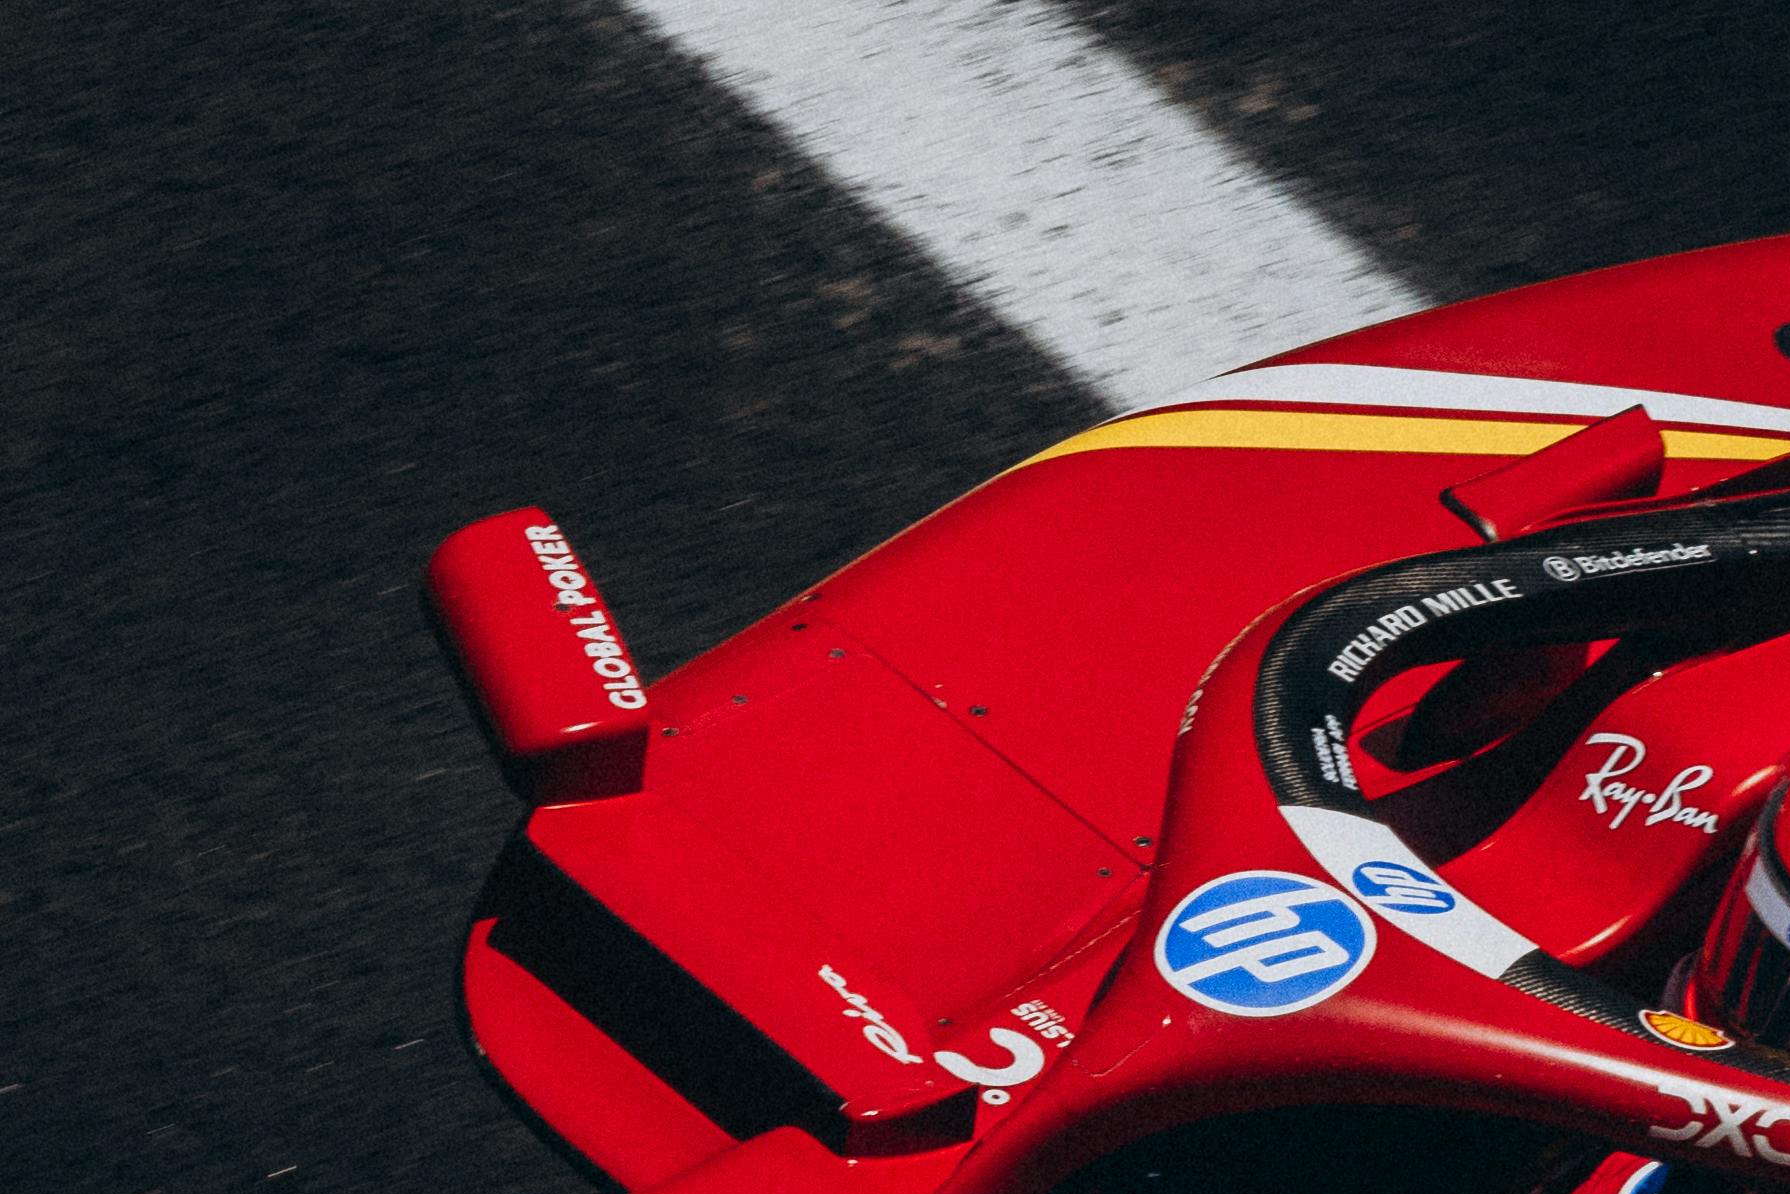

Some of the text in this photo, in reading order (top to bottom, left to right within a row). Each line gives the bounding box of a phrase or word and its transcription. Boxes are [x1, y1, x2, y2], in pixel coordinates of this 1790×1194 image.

[1573, 543, 1714, 576] Bitdefender
[524, 523, 648, 711] GLOBAL POKER
[1326, 577, 1525, 684] RICHARD MILLE
